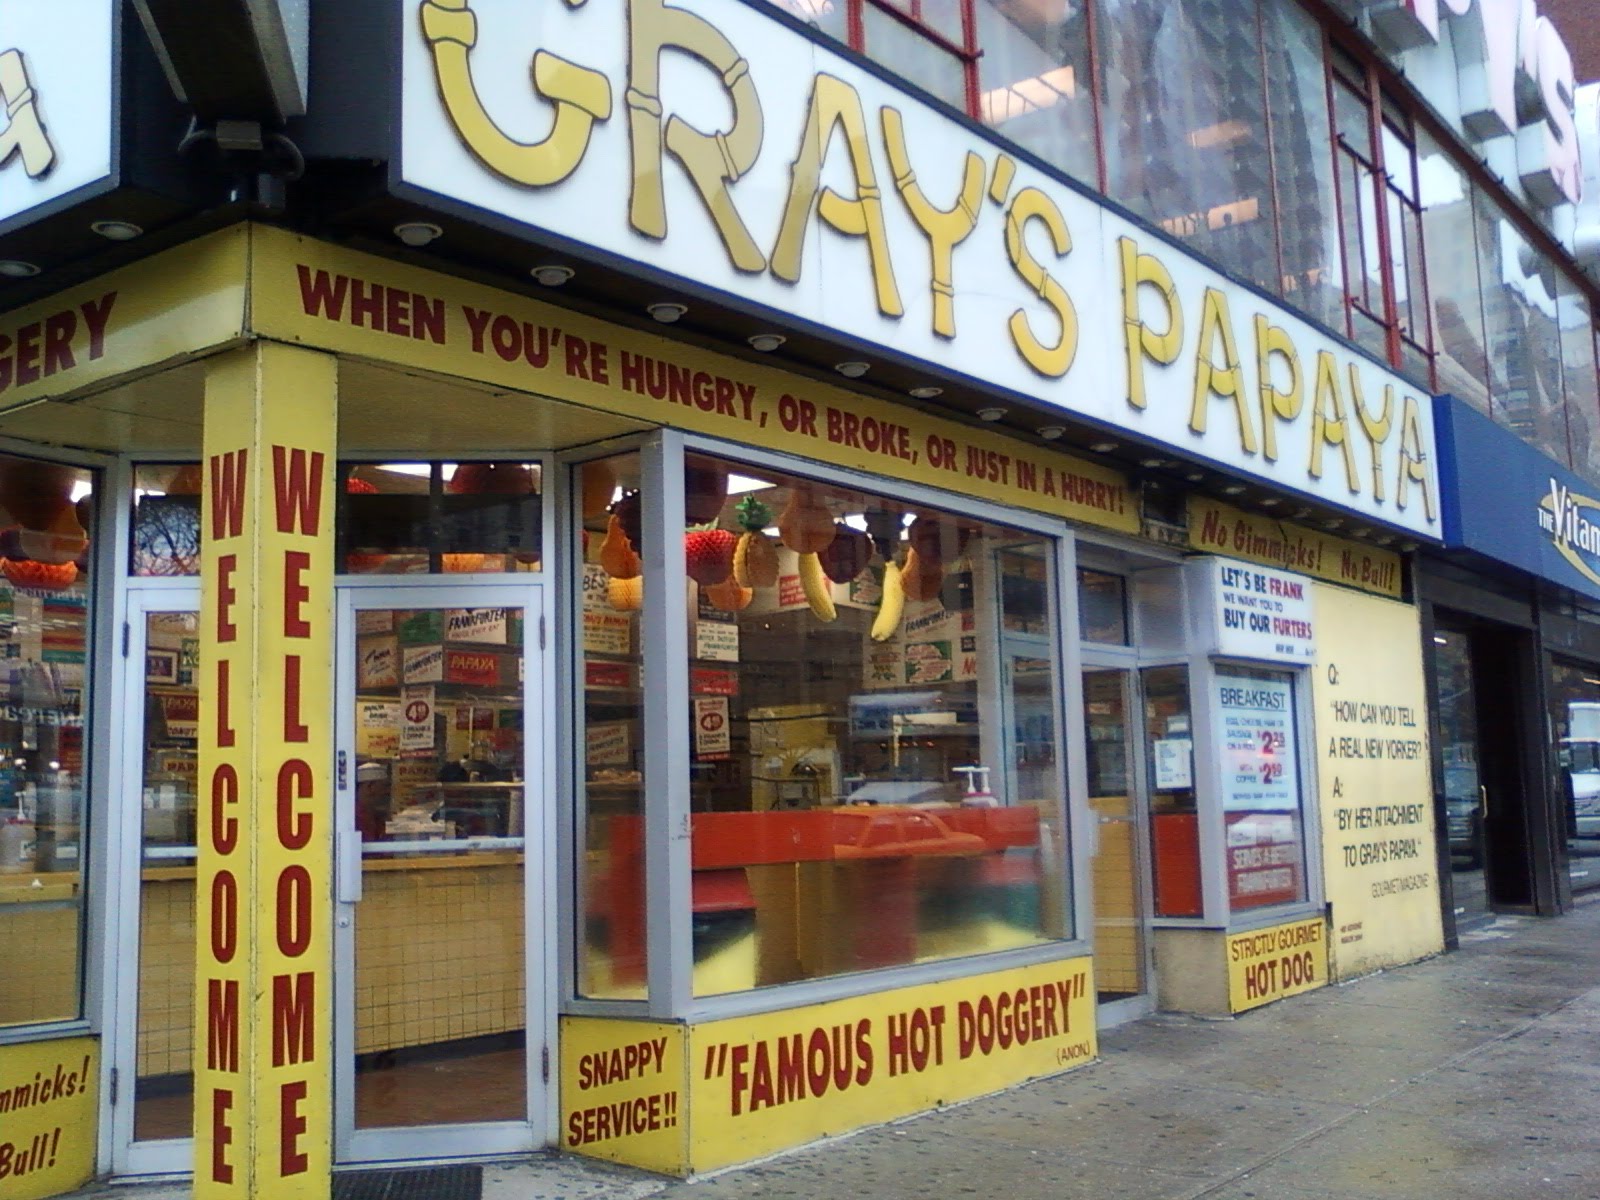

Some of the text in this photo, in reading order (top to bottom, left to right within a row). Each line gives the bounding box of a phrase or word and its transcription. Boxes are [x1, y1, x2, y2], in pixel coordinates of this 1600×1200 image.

[421, 0, 1079, 379] GRAY'S
[1116, 234, 1437, 523] PAPAYA
[296, 264, 1124, 515] WHEN YOU'RE HUNGRY, OR BROKE, OR JUST IN A HURRY!
[1537, 507, 1554, 533] THE
[1201, 509, 1228, 547] No
[1341, 550, 1358, 581] No
[1361, 555, 1395, 591] Bull!
[1221, 566, 1304, 601] LET'S BE FRANK
[1223, 592, 1283, 613] WE WANT YOU TO
[1224, 607, 1312, 640] BUY OUR FURTERS
[1221, 687, 1286, 709] BREAKFAST
[1360, 702, 1377, 724] CAN
[1379, 704, 1396, 726] YOU
[1398, 705, 1416, 727] TELL
[1328, 736, 1422, 760] A REAL NEW YORKER?
[207, 448, 249, 1185] WELCOME
[270, 444, 325, 1179] WELCOME
[1355, 807, 1373, 829] HER
[1374, 803, 1424, 826] ATTACHMENT
[1343, 845, 1358, 868] TO
[1360, 840, 1388, 866] GRAY'S
[1231, 921, 1323, 962] STRICTLY GOURMET
[1245, 950, 1314, 1000] HOT DOG
[578, 1036, 668, 1091] SNAPPY
[703, 973, 1086, 1117] "FAMOUS HOT DOGGERY"
[567, 1090, 677, 1147] SERVICE!!
[0, 1127, 62, 1180] Bull!
